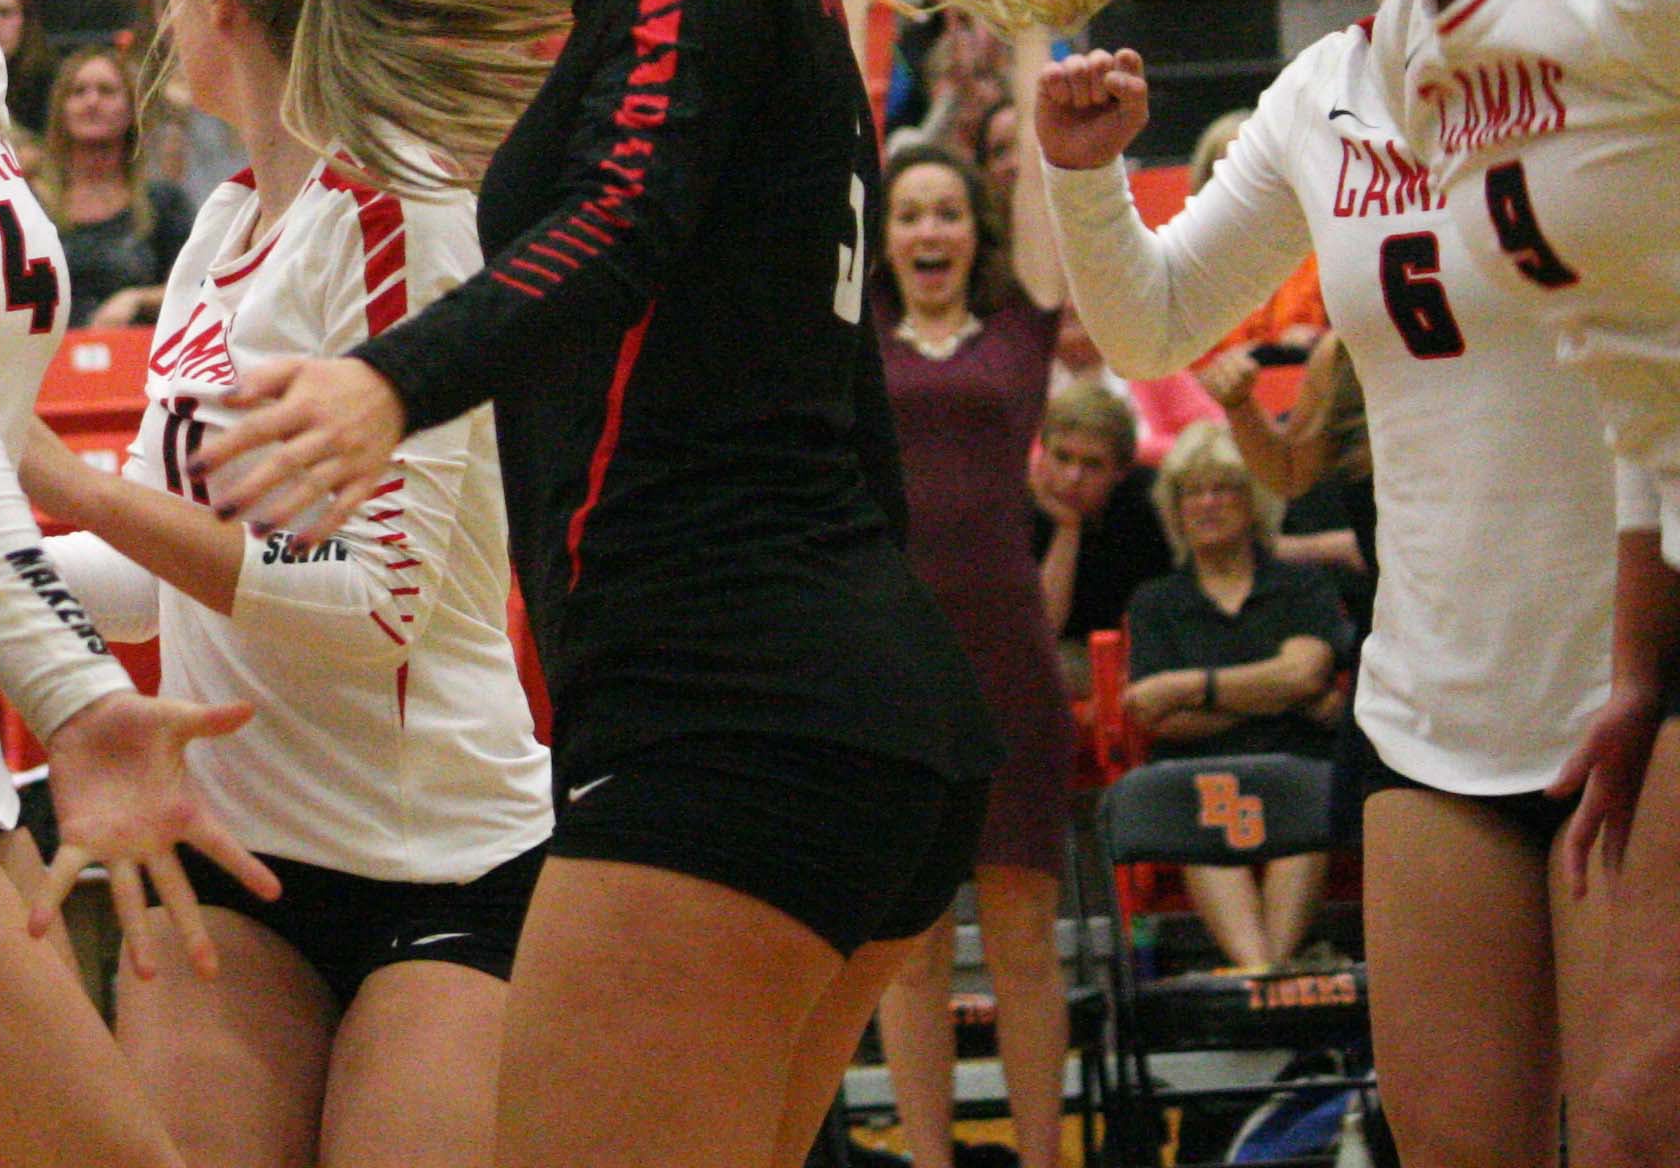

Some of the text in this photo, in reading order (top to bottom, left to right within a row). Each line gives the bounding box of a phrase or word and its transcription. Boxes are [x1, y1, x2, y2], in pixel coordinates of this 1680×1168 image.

[1379, 230, 1466, 360] 6
[160, 395, 211, 507] 11
[1194, 772, 1265, 849] BG
